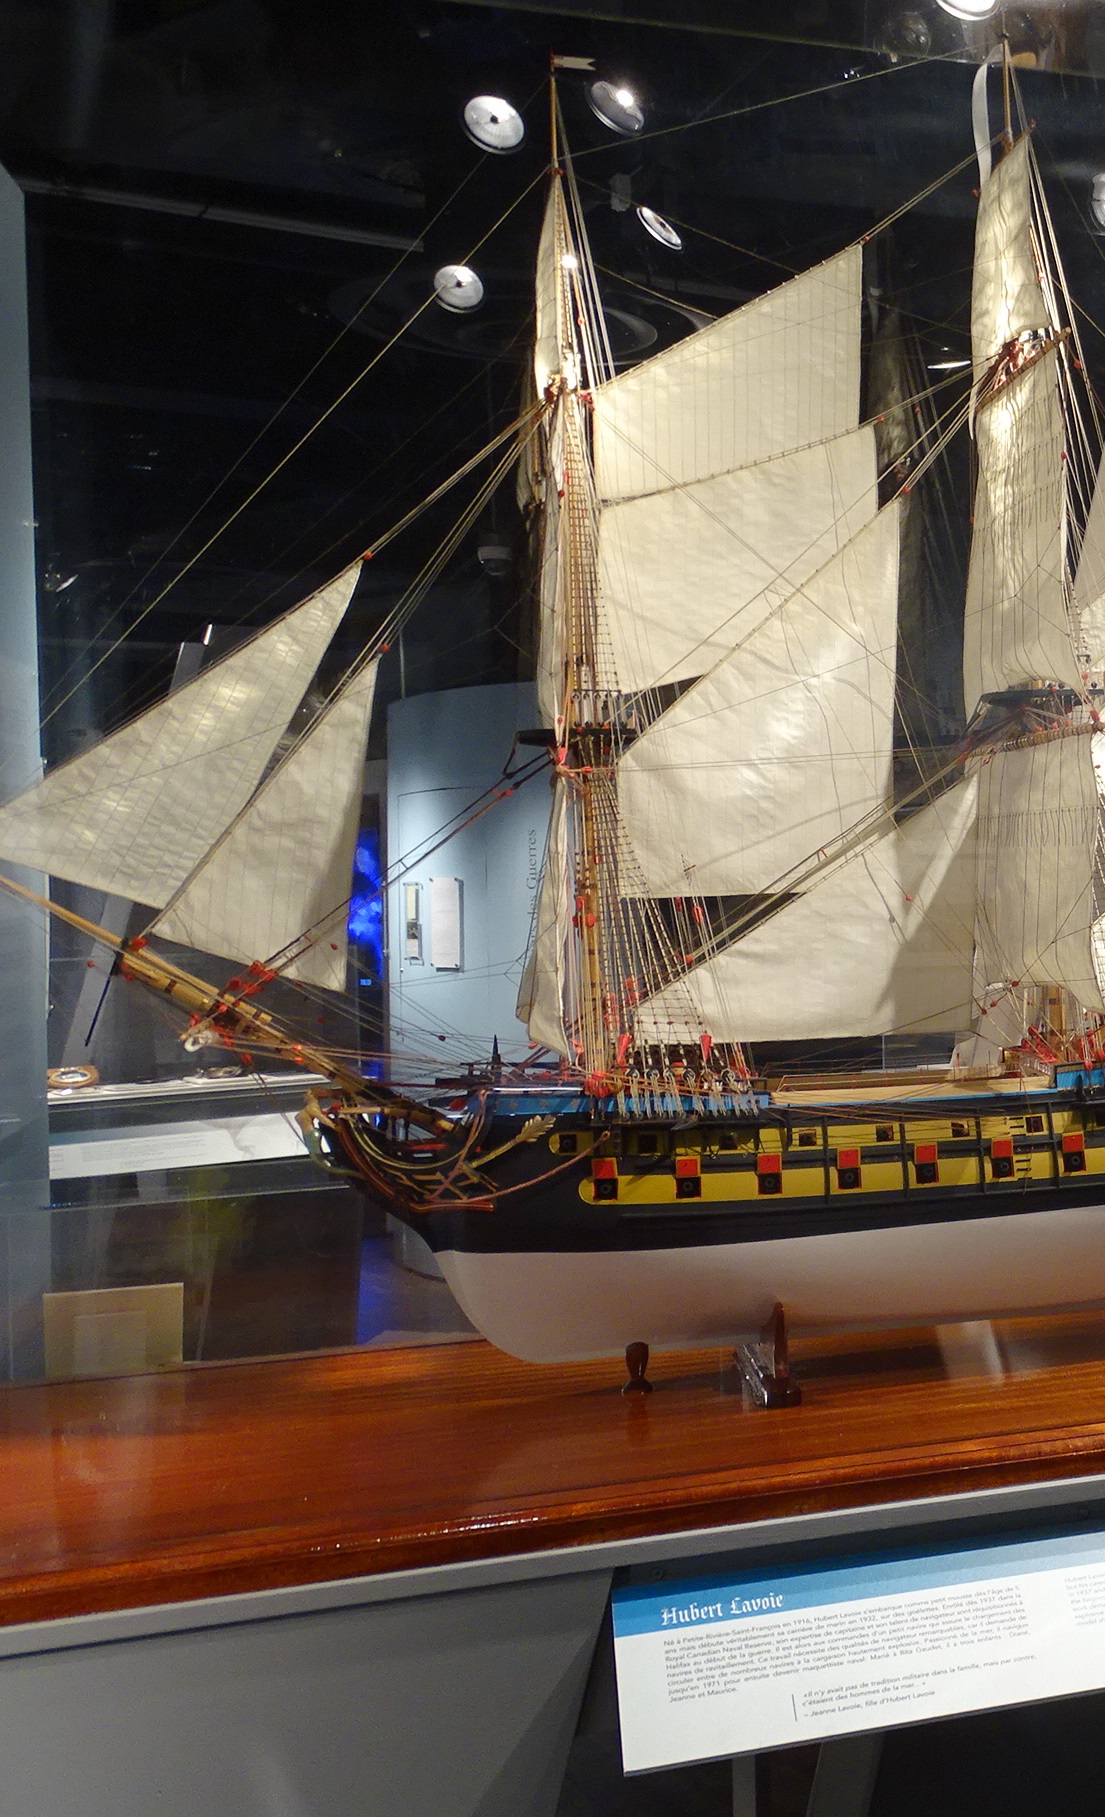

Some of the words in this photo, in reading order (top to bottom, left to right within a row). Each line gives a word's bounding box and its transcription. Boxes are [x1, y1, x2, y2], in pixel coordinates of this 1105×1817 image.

[526, 829, 537, 890] Guerres
[661, 1603, 723, 1626] Hubert
[730, 1593, 784, 1615] Lavoie
[682, 1623, 781, 1643] Petite-Rivière-Saint-François
[813, 1614, 838, 1622] Hubert
[863, 1605, 903, 1615] s'embarque
[930, 1597, 946, 1606] petit
[665, 1653, 685, 1662] Royal
[686, 1649, 721, 1658] Canadian
[722, 1644, 743, 1653] Naval
[744, 1641, 774, 1649] Reserve,
[790, 1633, 822, 1642] expertise
[834, 1626, 865, 1635] capitaine
[889, 1618, 908, 1626] talent
[920, 1612, 955, 1621] navigateur
[665, 1662, 690, 1670] Halifax
[703, 1655, 726, 1664] début
[827, 1633, 870, 1644] commandes
[888, 1627, 905, 1636] petit
[928, 1621, 940, 1629] qui
[972, 1610, 1011, 1621] chargement
[666, 1670, 692, 1678] navires
[770, 1652, 792, 1661] travail
[793, 1648, 826, 1657] nécessite
[841, 1641, 869, 1651] qualités
[881, 1634, 917, 1643] navigateur
[985, 1617, 1017, 1626] demande
[667, 1677, 694, 1686] circuler
[730, 1666, 767, 1676] nombreux
[812, 1653, 846, 1662] cargaison
[848, 1645, 885, 1656] hautement
[924, 1634, 958, 1644] Passionné
[698, 1640, 724, 1648] débute
[726, 1631, 775, 1644] véritablement
[787, 1626, 813, 1634] carrière
[668, 1685, 699, 1696] jusqu'en
[723, 1679, 741, 1687] pour
[744, 1673, 770, 1682] ensuite
[772, 1668, 799, 1677] devenir
[802, 1661, 844, 1672] maquettiste
[870, 1653, 890, 1661] Marié
[977, 1635, 1002, 1643] enfants
[826, 1686, 844, 1694] avait
[845, 1685, 858, 1693] pas
[870, 1678, 901, 1686] tradition
[902, 1673, 930, 1681] militaire
[957, 1664, 981, 1672] famille,
[669, 1694, 696, 1702] Jeanne
[802, 1696, 833, 1707] c'étaient
[849, 1690, 880, 1698] hommes
[810, 1708, 836, 1717] Jeanne
[838, 1703, 863, 1712] Lavoie,
[879, 1694, 911, 1704] d'Hubert
[912, 1690, 936, 1699] Lavoie
